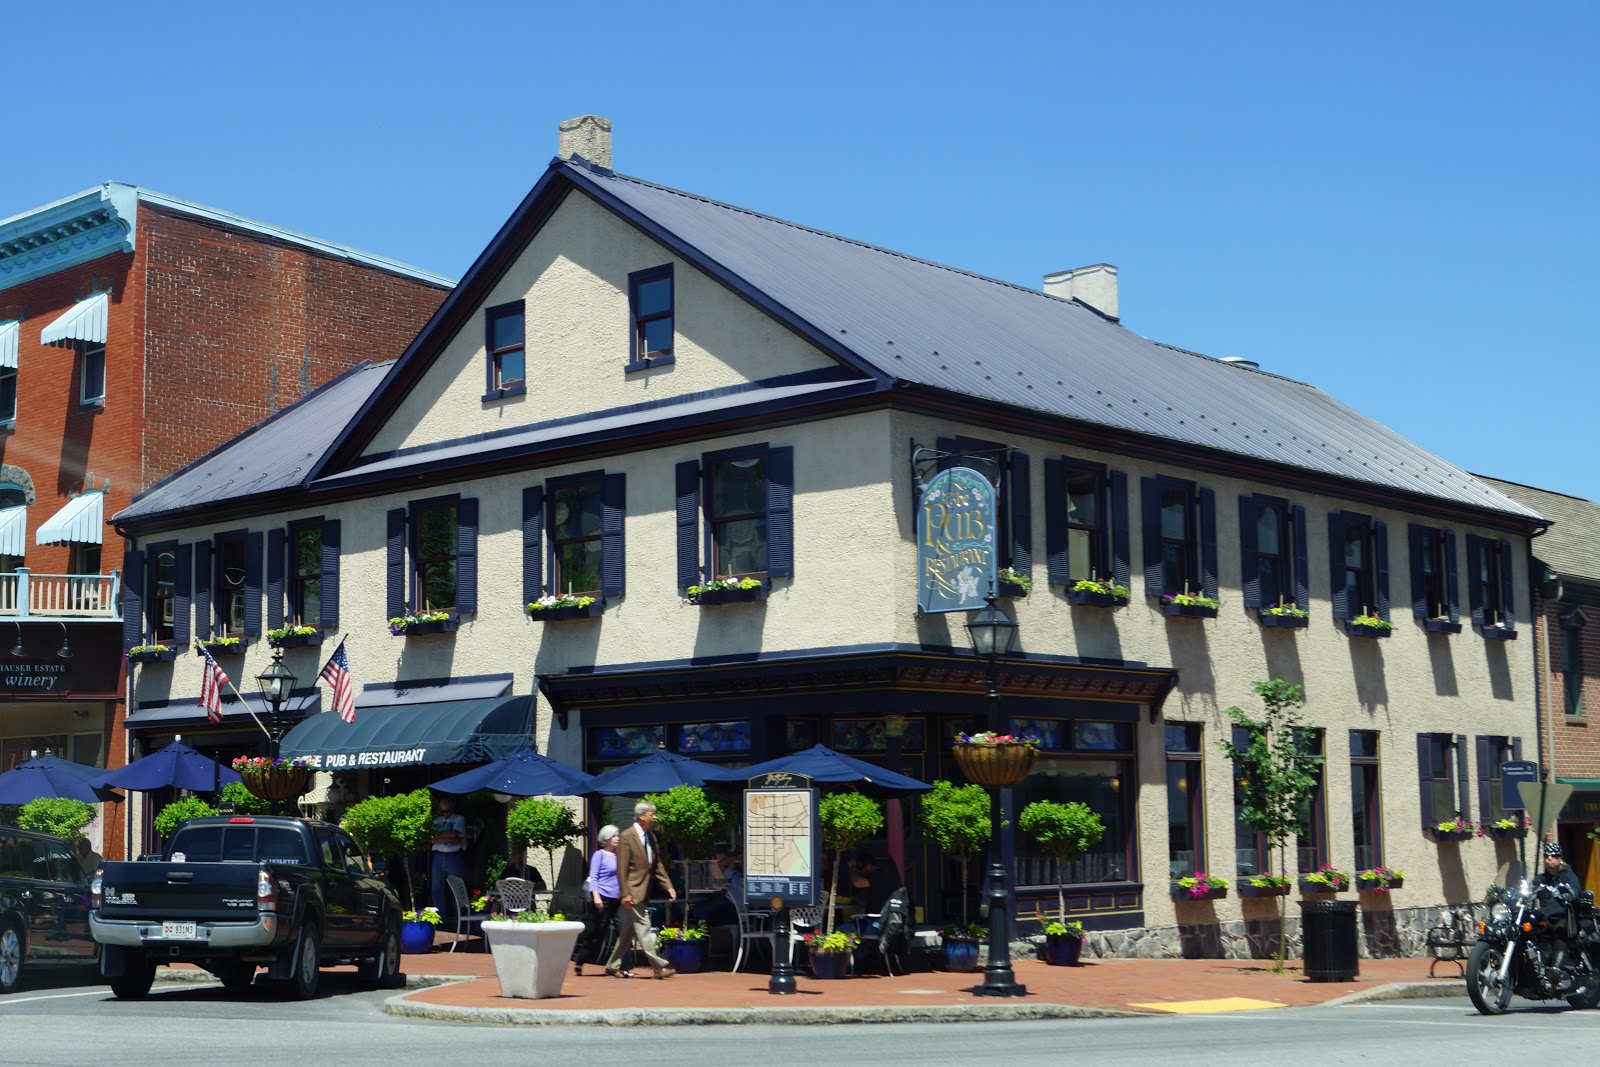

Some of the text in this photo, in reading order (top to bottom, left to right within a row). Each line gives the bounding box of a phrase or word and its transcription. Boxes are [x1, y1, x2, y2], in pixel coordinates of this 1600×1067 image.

[34, 664, 66, 672] ESTATE
[5, 672, 58, 690] winery
[325, 755, 346, 768] PUB
[348, 755, 356, 766] &
[358, 748, 426, 765] RESTAURANT
